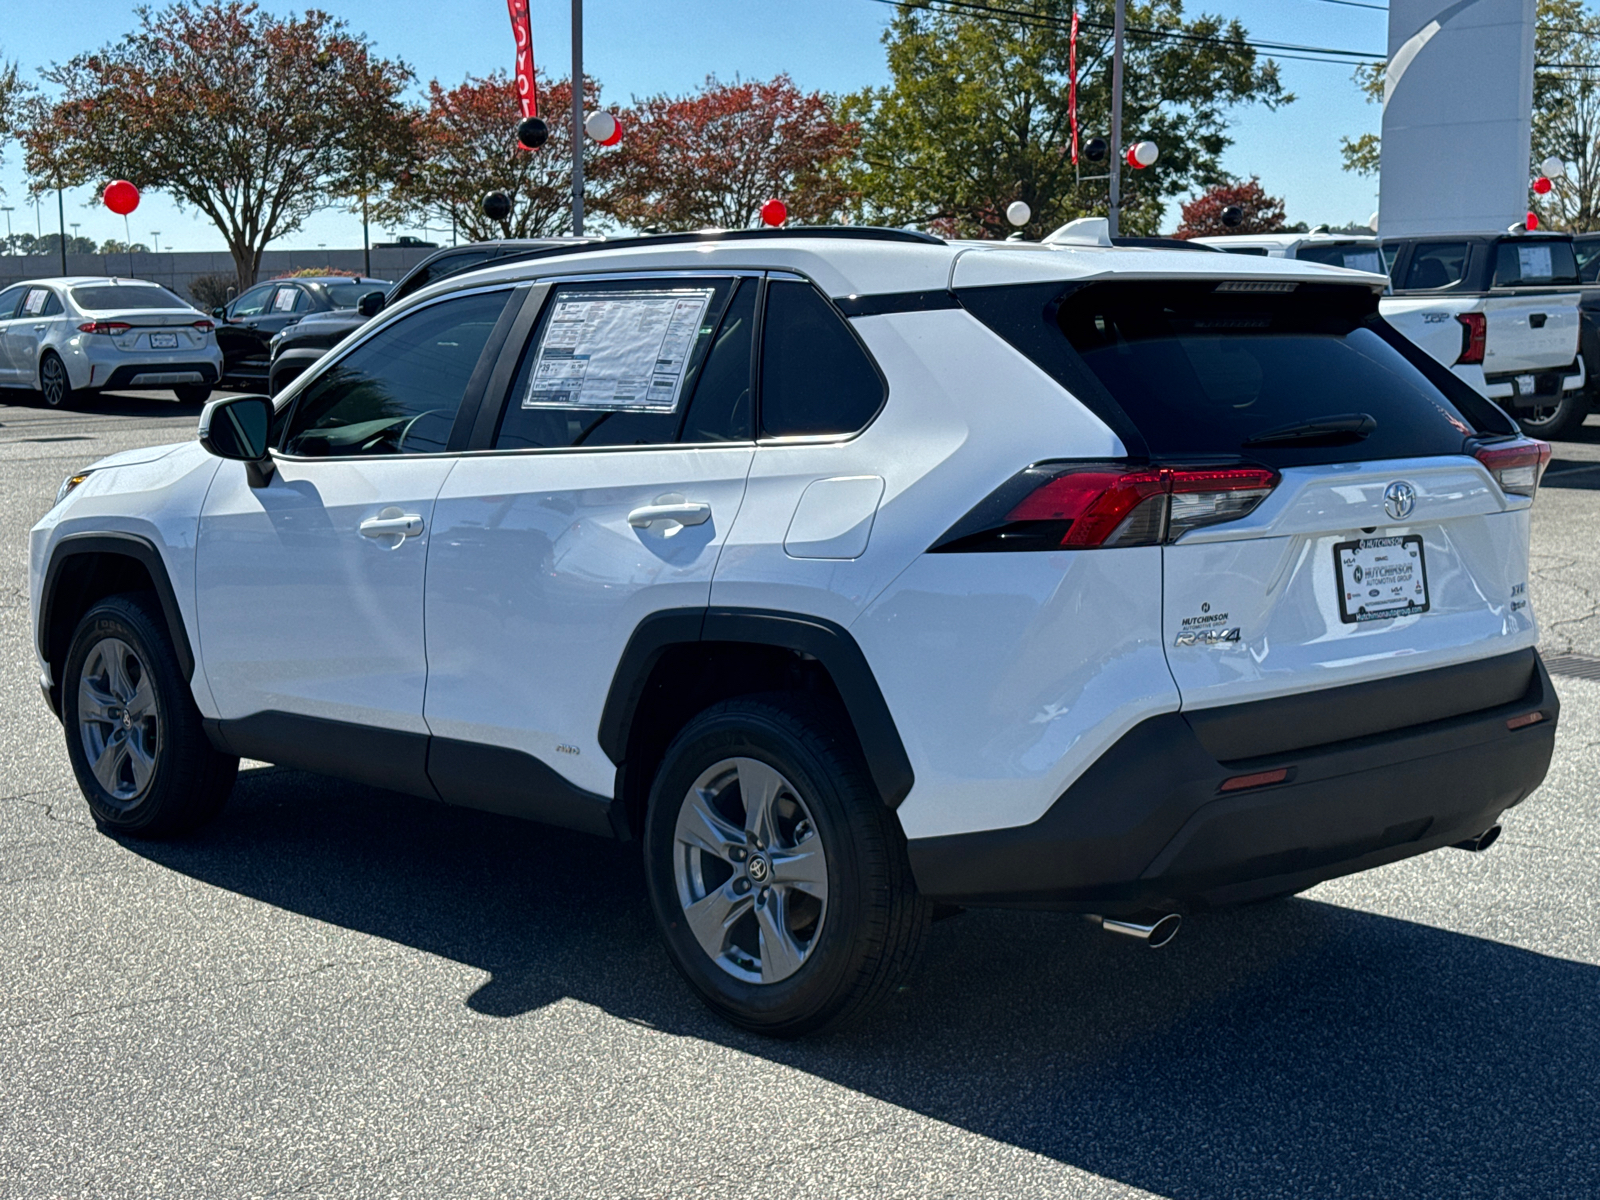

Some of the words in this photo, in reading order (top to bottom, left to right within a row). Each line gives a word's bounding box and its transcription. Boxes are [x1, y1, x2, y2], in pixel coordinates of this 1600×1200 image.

[1364, 563, 1413, 579] HUTCHINSON
[1366, 577, 1397, 587] AUTOMOTIVE
[1396, 574, 1413, 583] GROUP
[1182, 613, 1229, 626] HUTCHINSON
[1182, 623, 1212, 631] AUTOMOTIVE
[1174, 627, 1241, 647] RAV4
